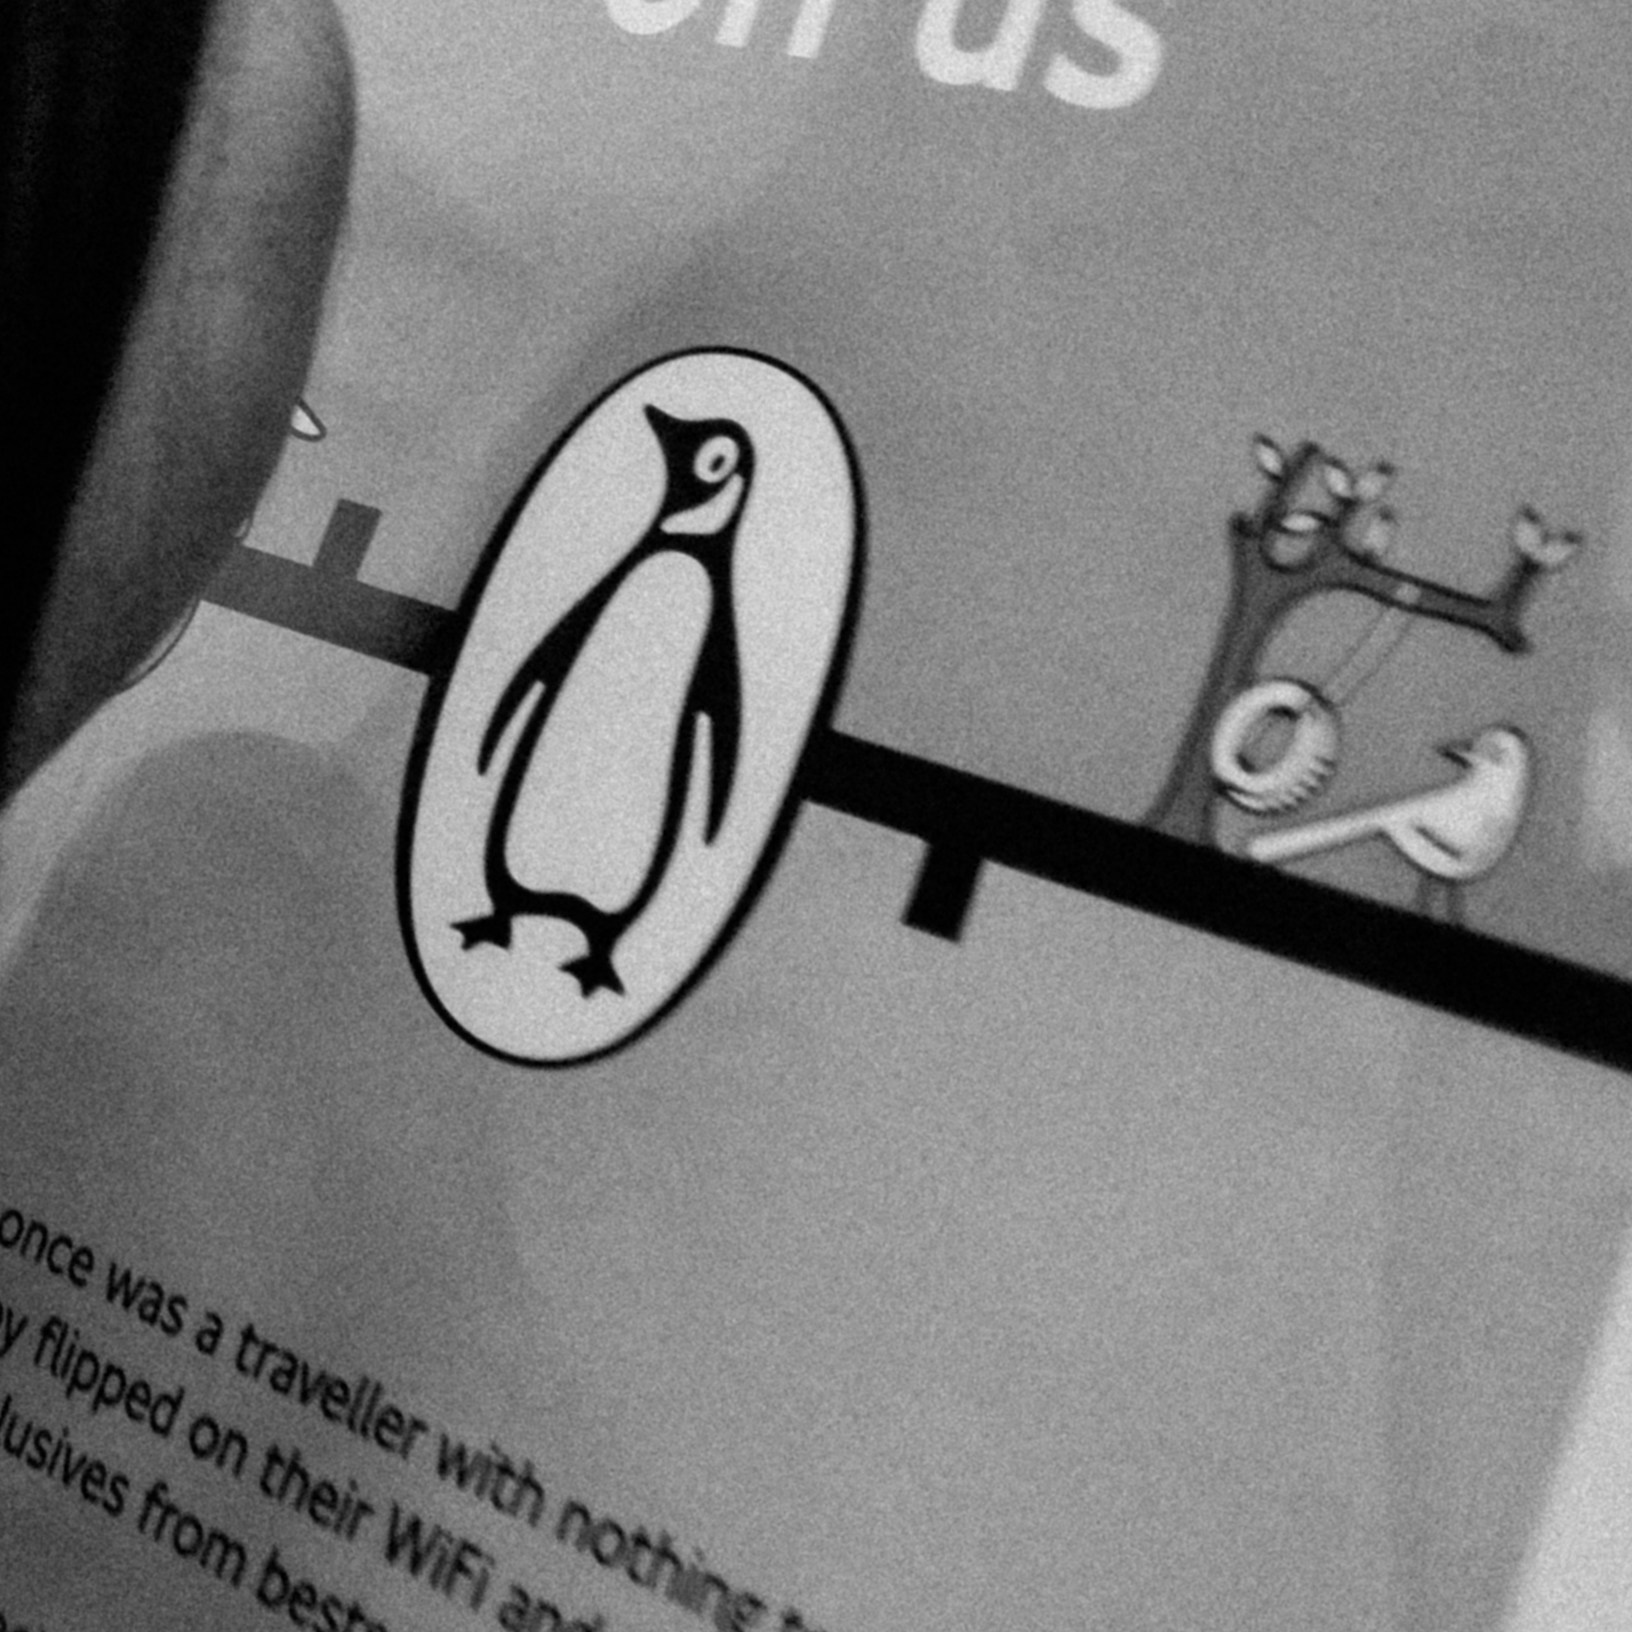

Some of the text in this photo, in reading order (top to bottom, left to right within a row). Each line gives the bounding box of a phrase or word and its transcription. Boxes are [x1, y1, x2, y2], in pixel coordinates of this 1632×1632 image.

[35, 1316, 185, 1439] flipped
[189, 1414, 248, 1479] on
[260, 1442, 375, 1541] their
[386, 1498, 496, 1614] WiFi
[106, 1262, 187, 1337] was
[195, 1311, 223, 1355] a
[235, 1322, 429, 1461] traveller
[437, 1433, 544, 1528] with
[139, 1481, 247, 1589] from
